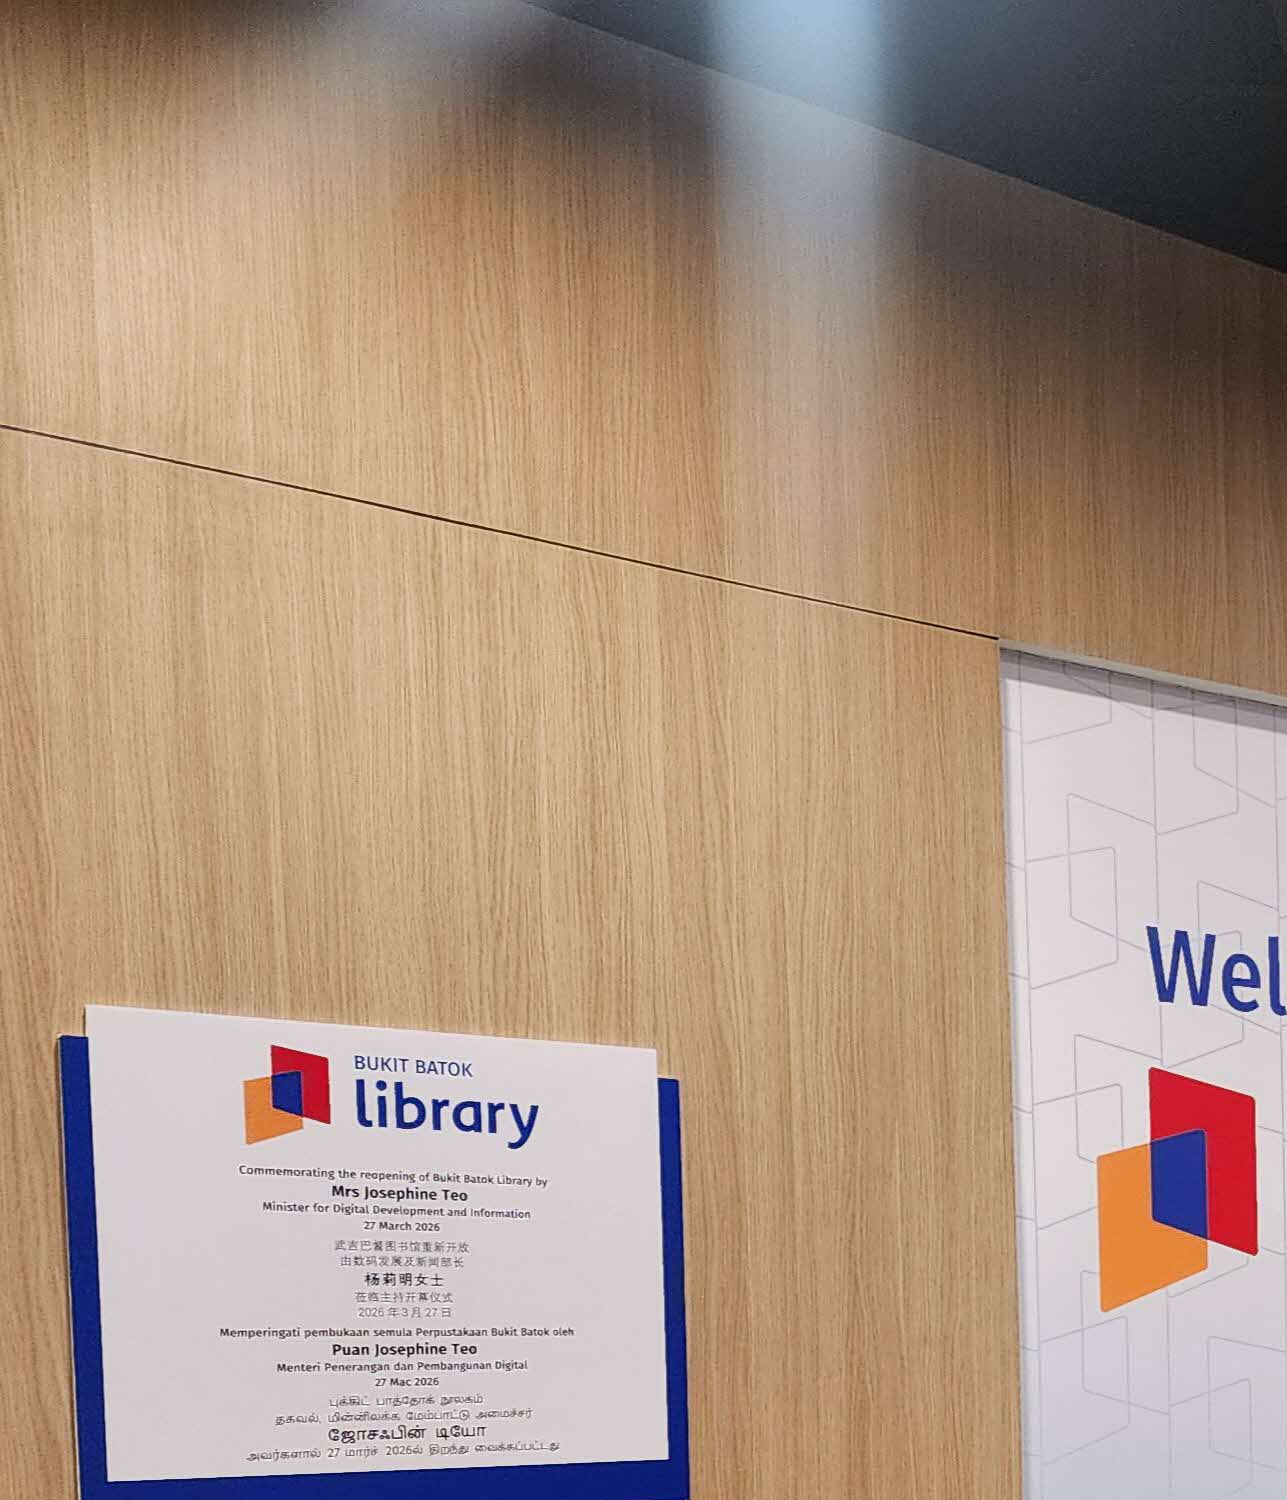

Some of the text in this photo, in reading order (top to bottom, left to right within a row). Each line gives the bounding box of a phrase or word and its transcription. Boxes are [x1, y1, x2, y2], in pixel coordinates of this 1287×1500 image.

[354, 1055, 473, 1078] BUKIT BATOK
[356, 1080, 539, 1150] library
[239, 1165, 548, 1188] Commemorating the reopening of Bukit Batok Library by
[331, 1185, 468, 1202] Mrs Josephine Teo
[262, 1201, 531, 1219] Minister for Digital Development and Information
[363, 1221, 440, 1232] 27 March 2026
[364, 1272, 444, 1287] 杨莉明女士
[220, 1326, 574, 1339] Memperingati pembukaan semula Perpustakaan Bukit Batok oleh
[332, 1343, 478, 1358] Puan Josephine Teo
[277, 1359, 528, 1373] Menteri Penerangan dan Pembangunan Digital
[375, 1377, 439, 1387] 27 Mac 2026
[328, 1424, 487, 1443] ஜோசஃபின் டியோ
[328, 1448, 340, 1458] 27
